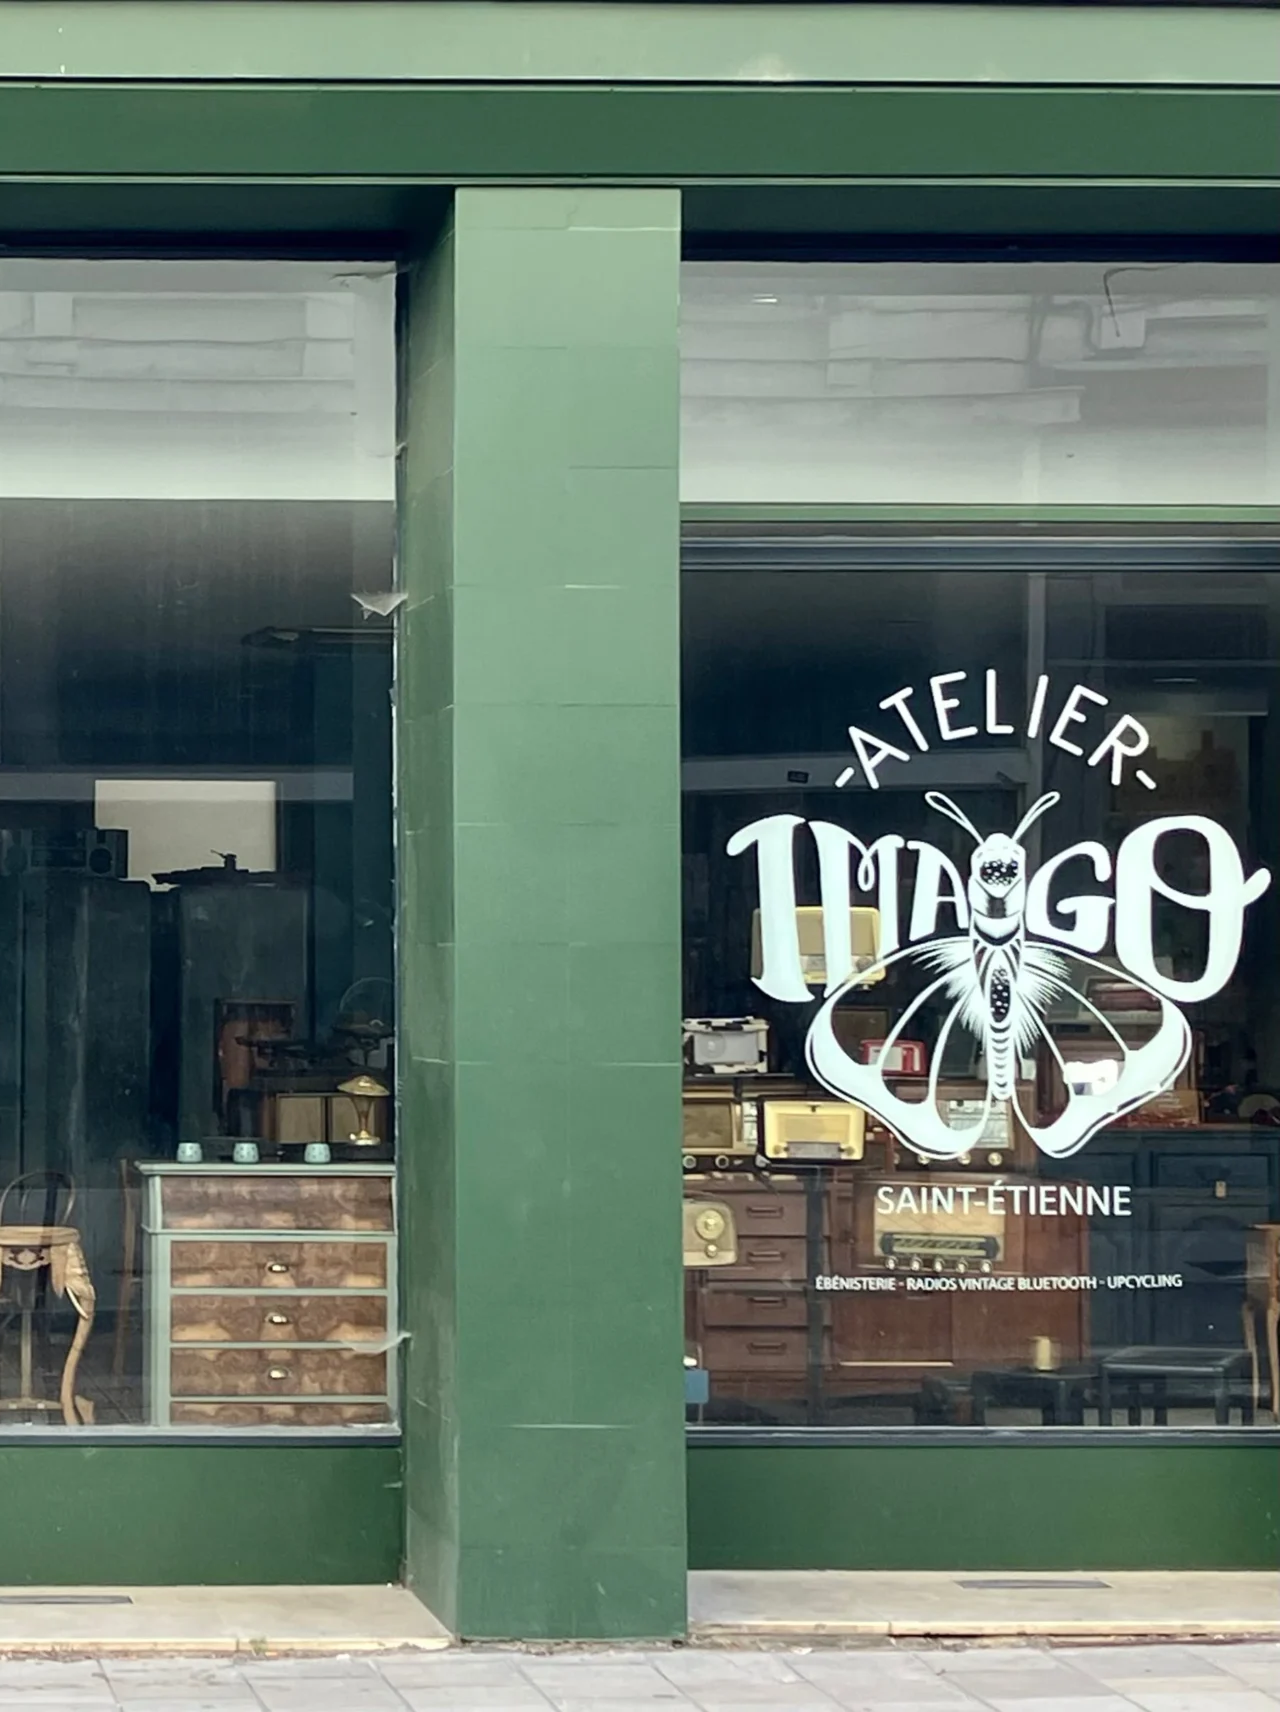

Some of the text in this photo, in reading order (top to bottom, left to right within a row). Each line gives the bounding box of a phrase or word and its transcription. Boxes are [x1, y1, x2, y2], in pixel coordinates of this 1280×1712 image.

[726, 813, 1272, 1003] IMAGO
[876, 1180, 1132, 1216] SAINT-ÉTIENNE
[815, 1275, 896, 1291] ÉBÉNISTERIE
[907, 1275, 957, 1291] RADIOS
[958, 1276, 1015, 1291] VINTAGE
[1017, 1275, 1097, 1291] BLUETOOTH
[1107, 1274, 1183, 1289] UPCYCLING
